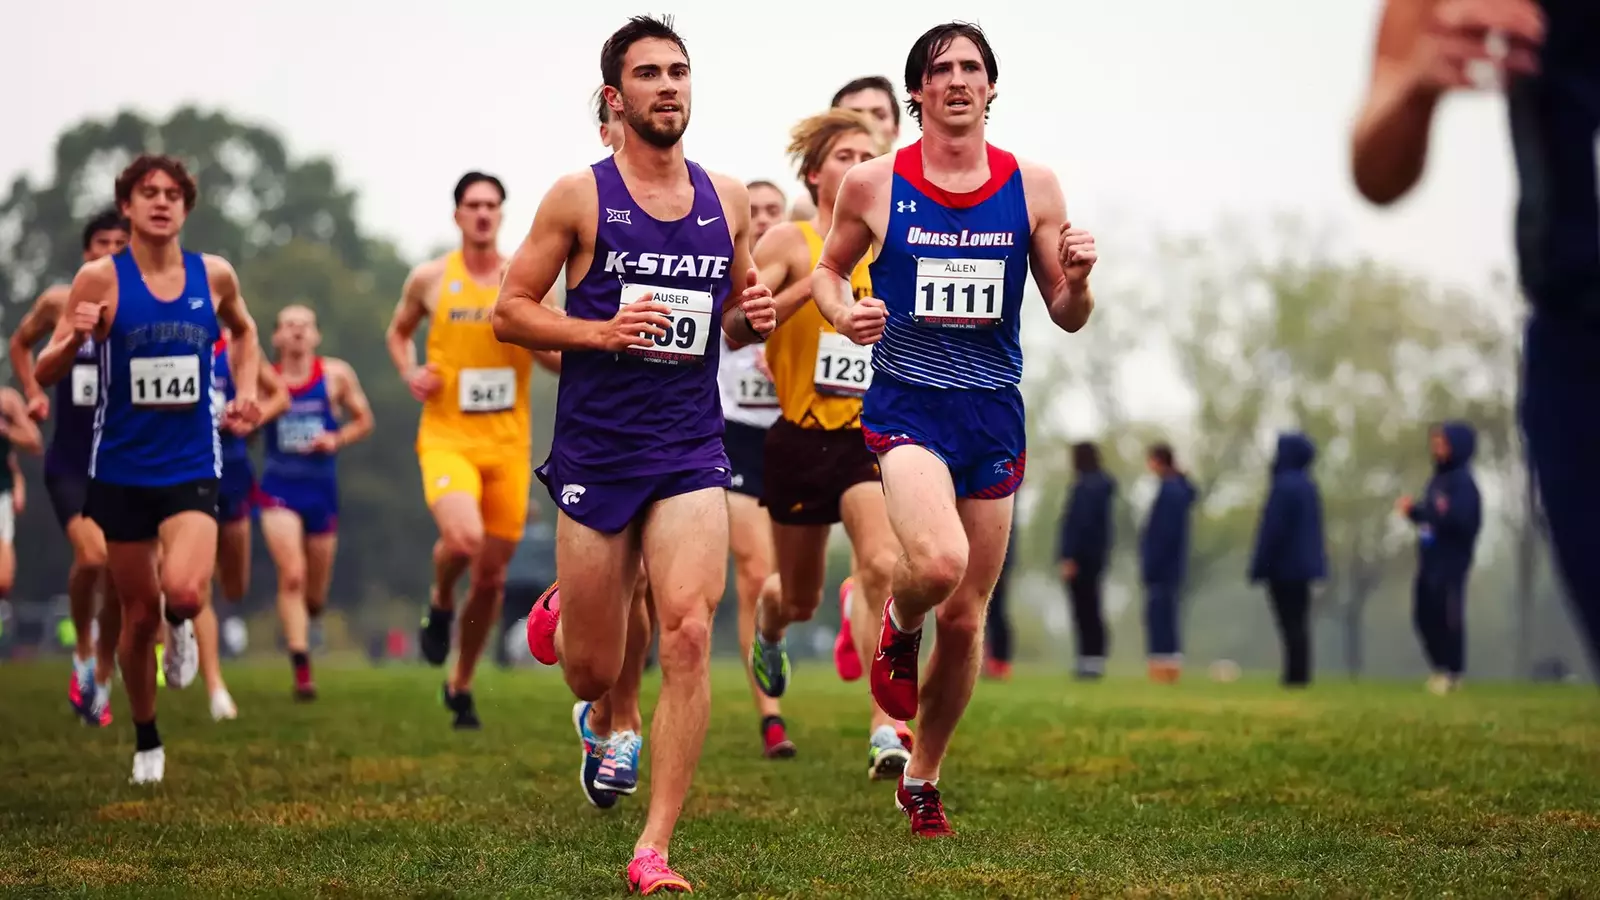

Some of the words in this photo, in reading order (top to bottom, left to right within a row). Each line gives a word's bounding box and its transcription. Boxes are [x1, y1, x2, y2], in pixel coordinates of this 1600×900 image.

[604, 251, 729, 279] K-STATE
[944, 264, 976, 273] ALLEN
[646, 292, 689, 305] AUSER
[921, 282, 995, 313] 1111
[640, 314, 696, 349] 59
[136, 376, 195, 399] 1144
